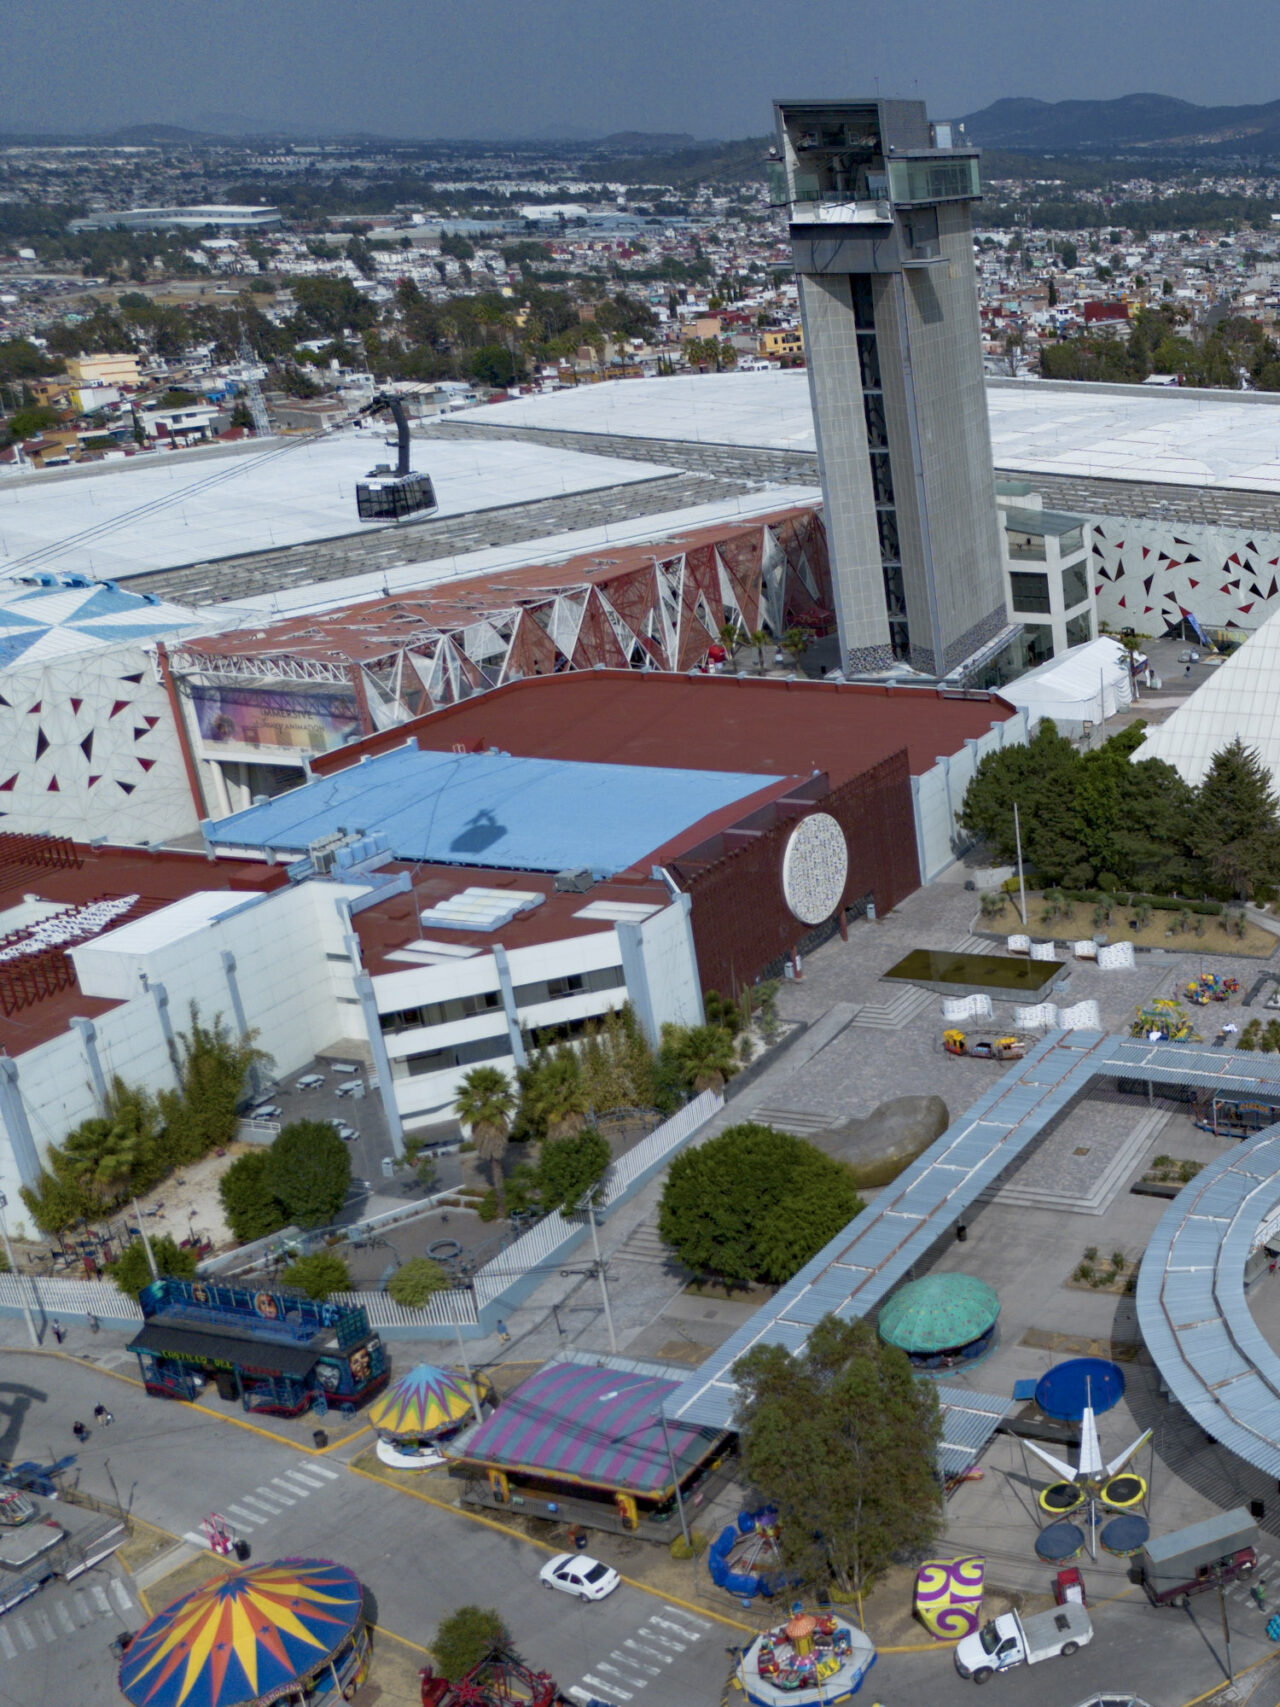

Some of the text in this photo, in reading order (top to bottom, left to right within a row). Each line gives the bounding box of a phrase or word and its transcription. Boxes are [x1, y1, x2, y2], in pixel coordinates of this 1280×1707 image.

[261, 708, 314, 720] IMMERSIVE
[285, 724, 326, 733] ANIMATION
[162, 1350, 207, 1364] CASTILLO
